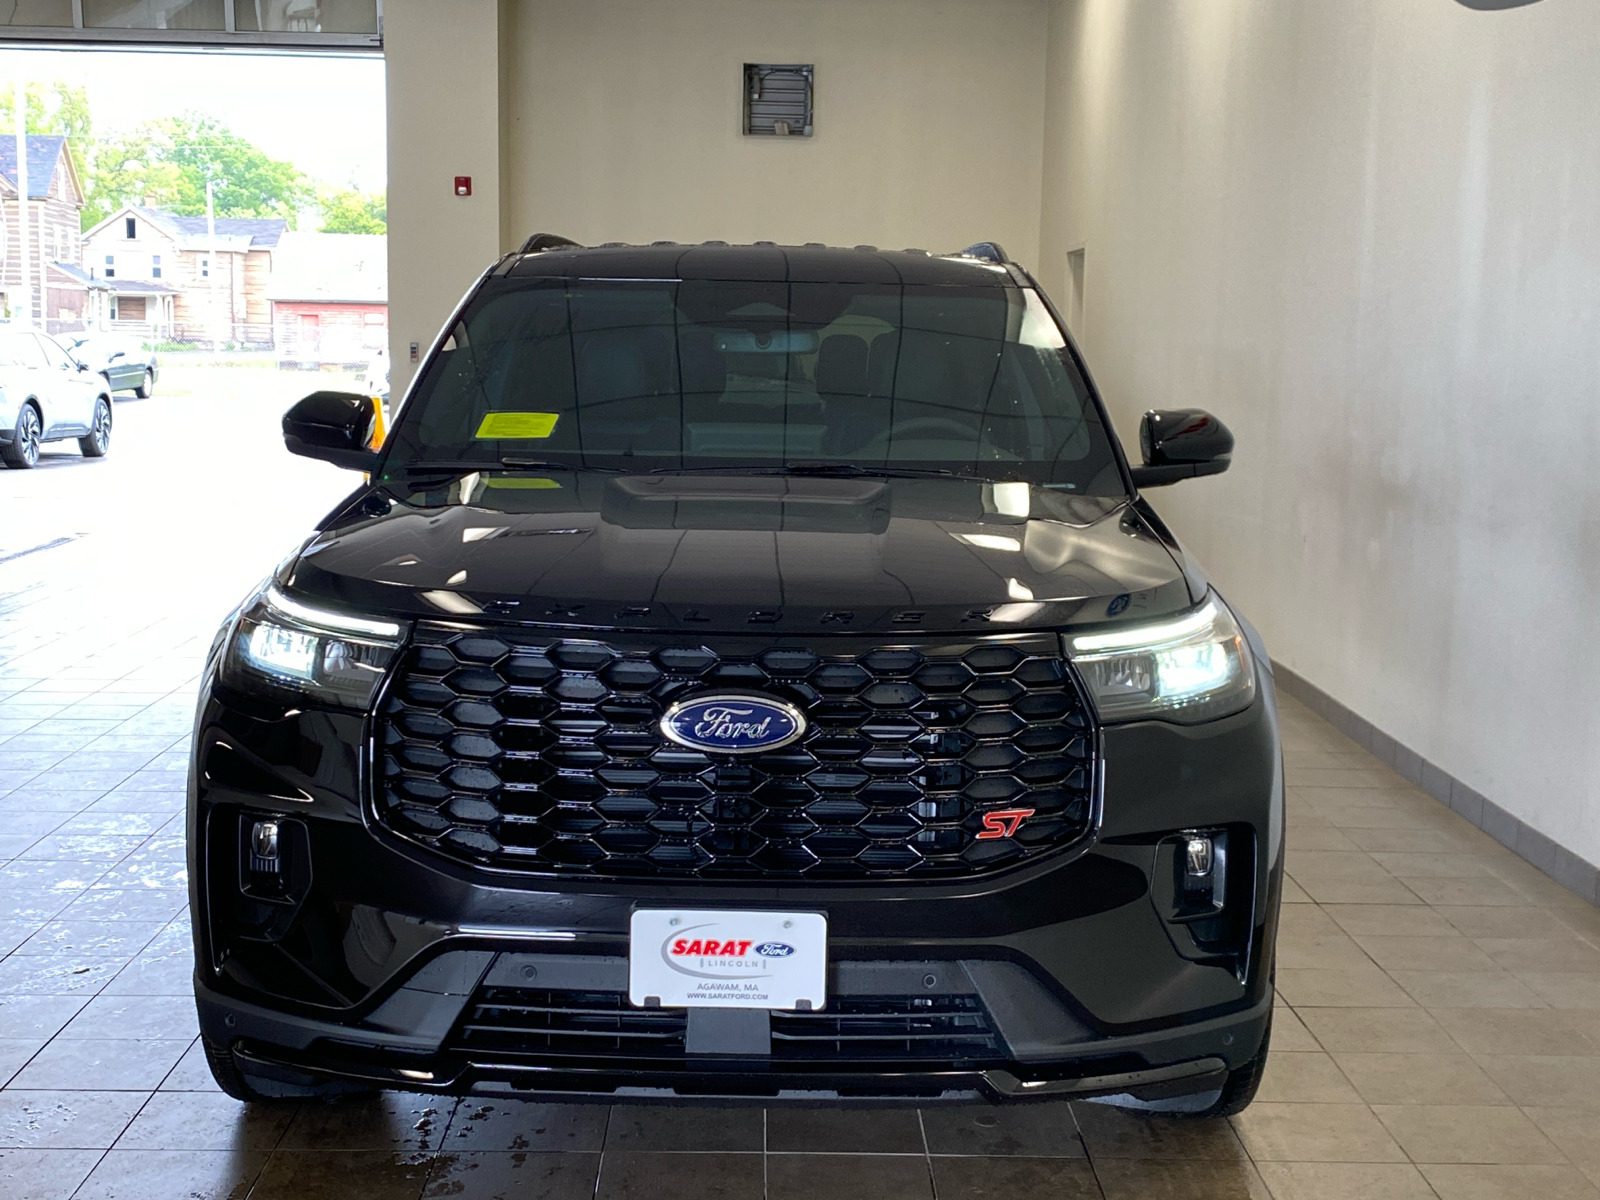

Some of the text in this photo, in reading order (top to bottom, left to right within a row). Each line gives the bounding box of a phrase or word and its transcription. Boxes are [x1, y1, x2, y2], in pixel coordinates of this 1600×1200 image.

[483, 600, 995, 623] EXPLORER
[695, 707, 772, 738] Ford
[975, 808, 1035, 839] ST
[670, 938, 789, 957] SARAT Ford
[708, 960, 758, 968] LINCOLN
[697, 983, 759, 992] AGAWAM, MA
